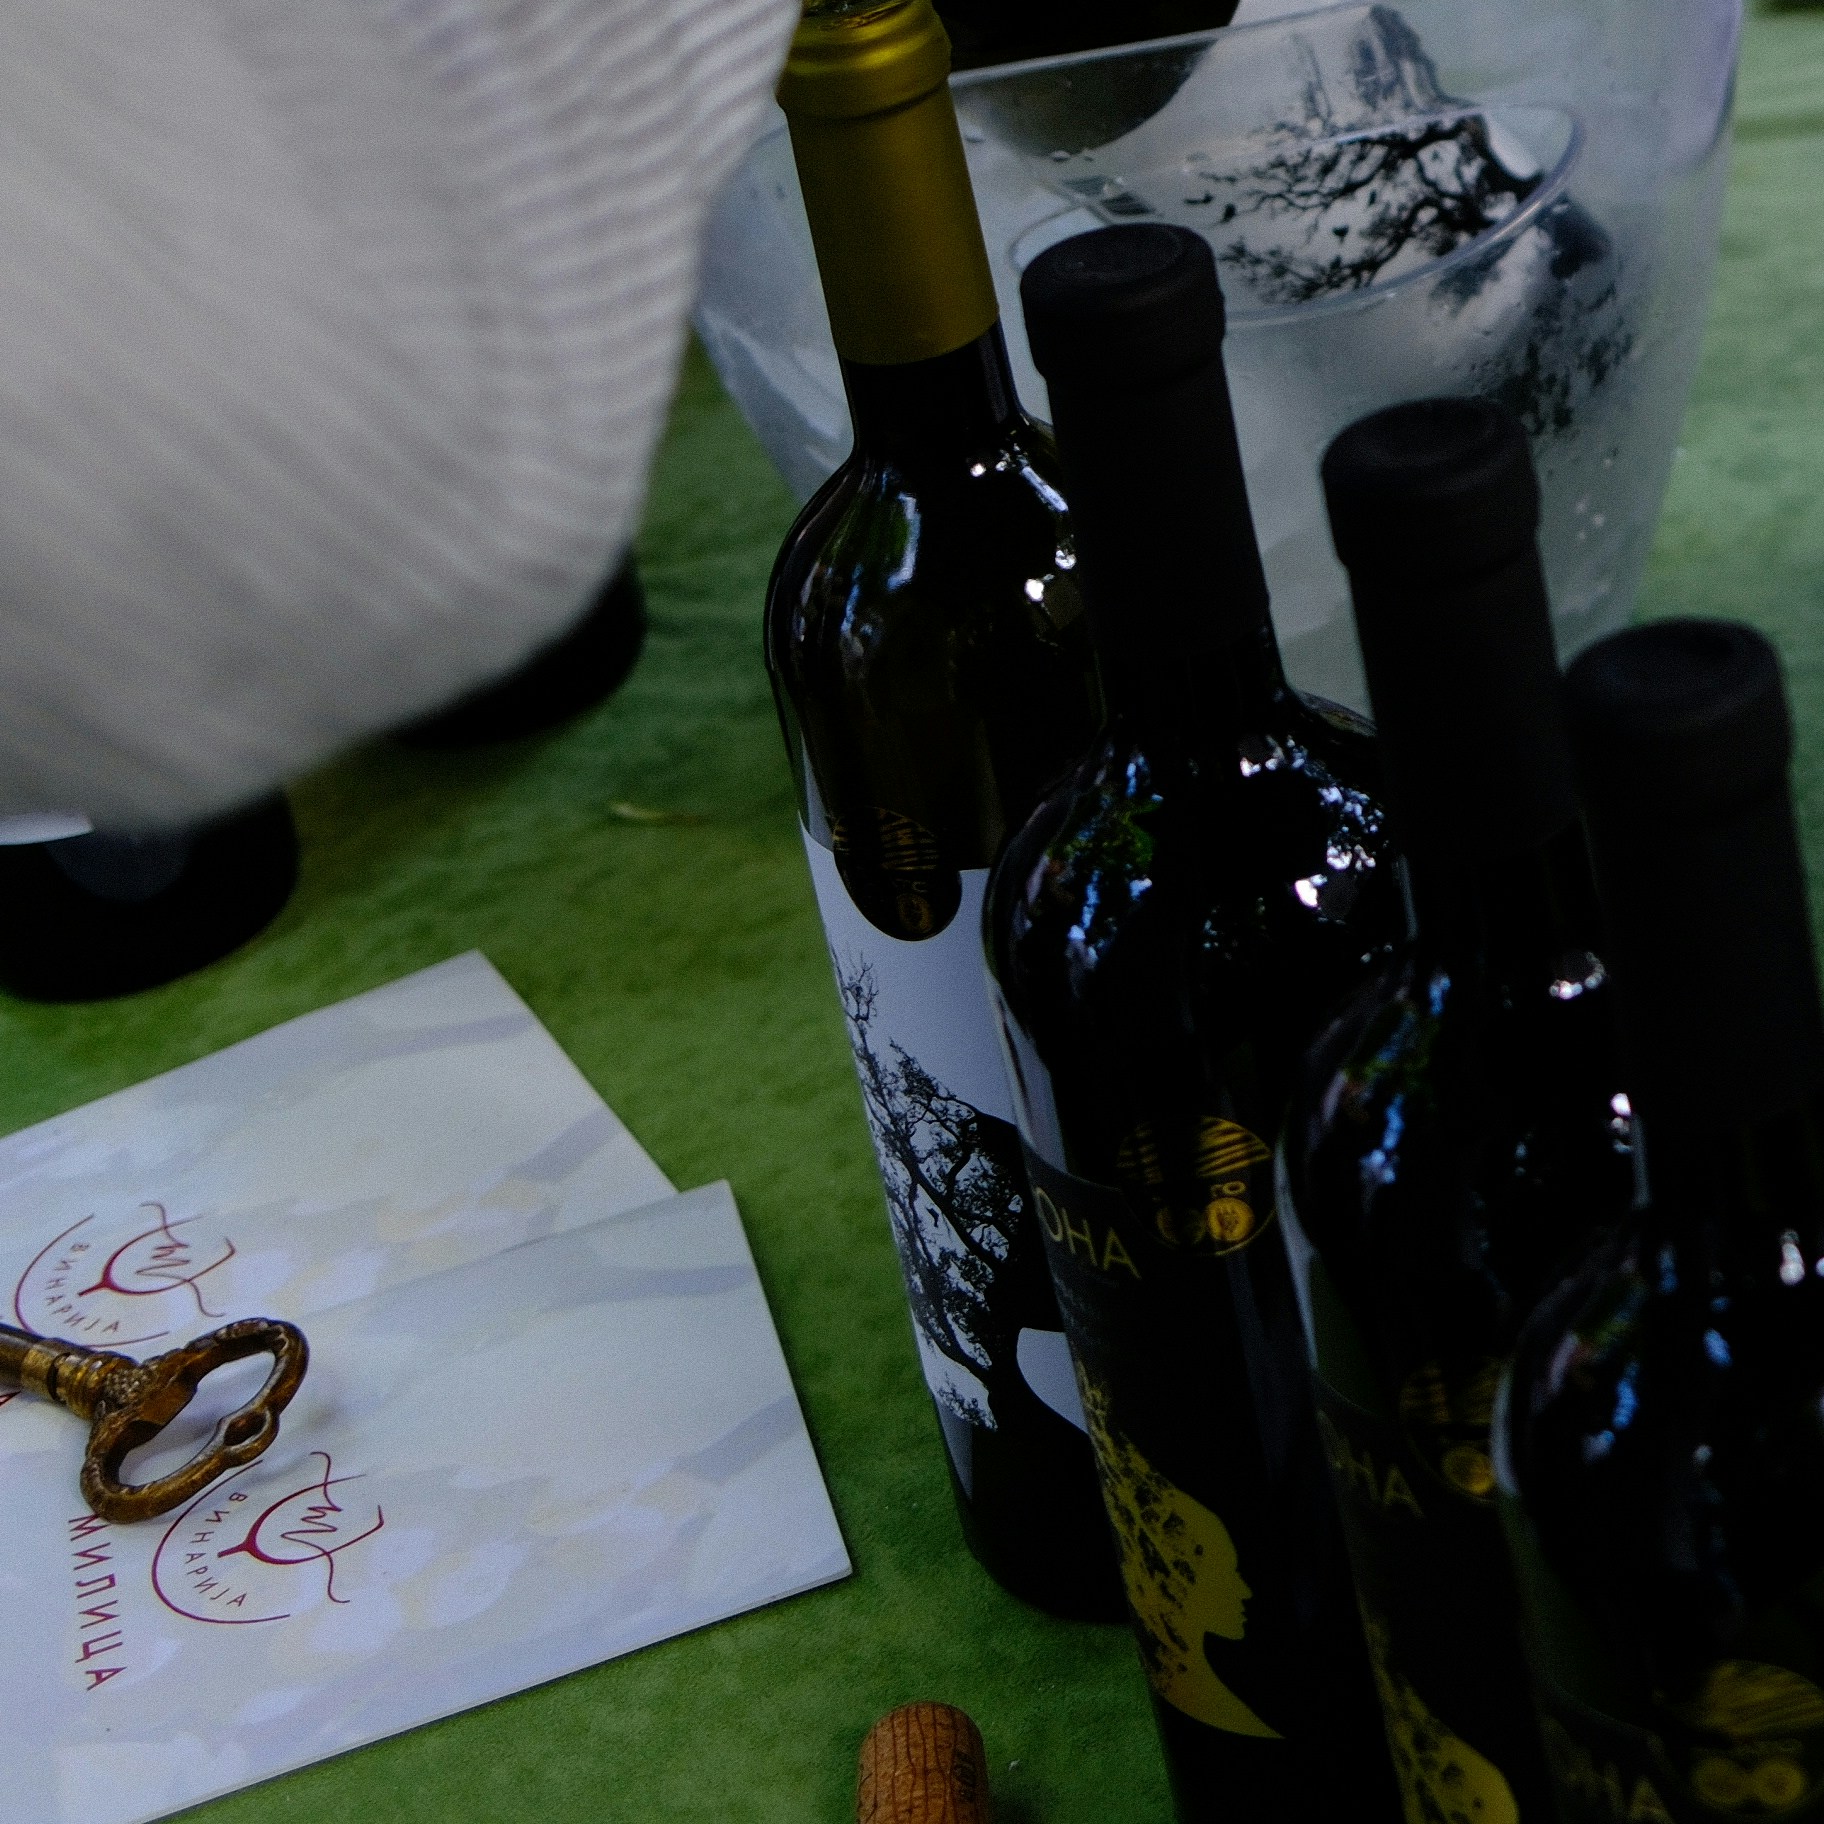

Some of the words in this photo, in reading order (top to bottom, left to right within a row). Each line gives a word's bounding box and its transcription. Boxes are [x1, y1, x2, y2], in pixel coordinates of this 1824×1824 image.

[44, 1242, 120, 1333] ВИНАРИЈА
[68, 1513, 128, 1691] МИЛИЦА
[184, 1492, 248, 1608] ВИНАРИЈА
